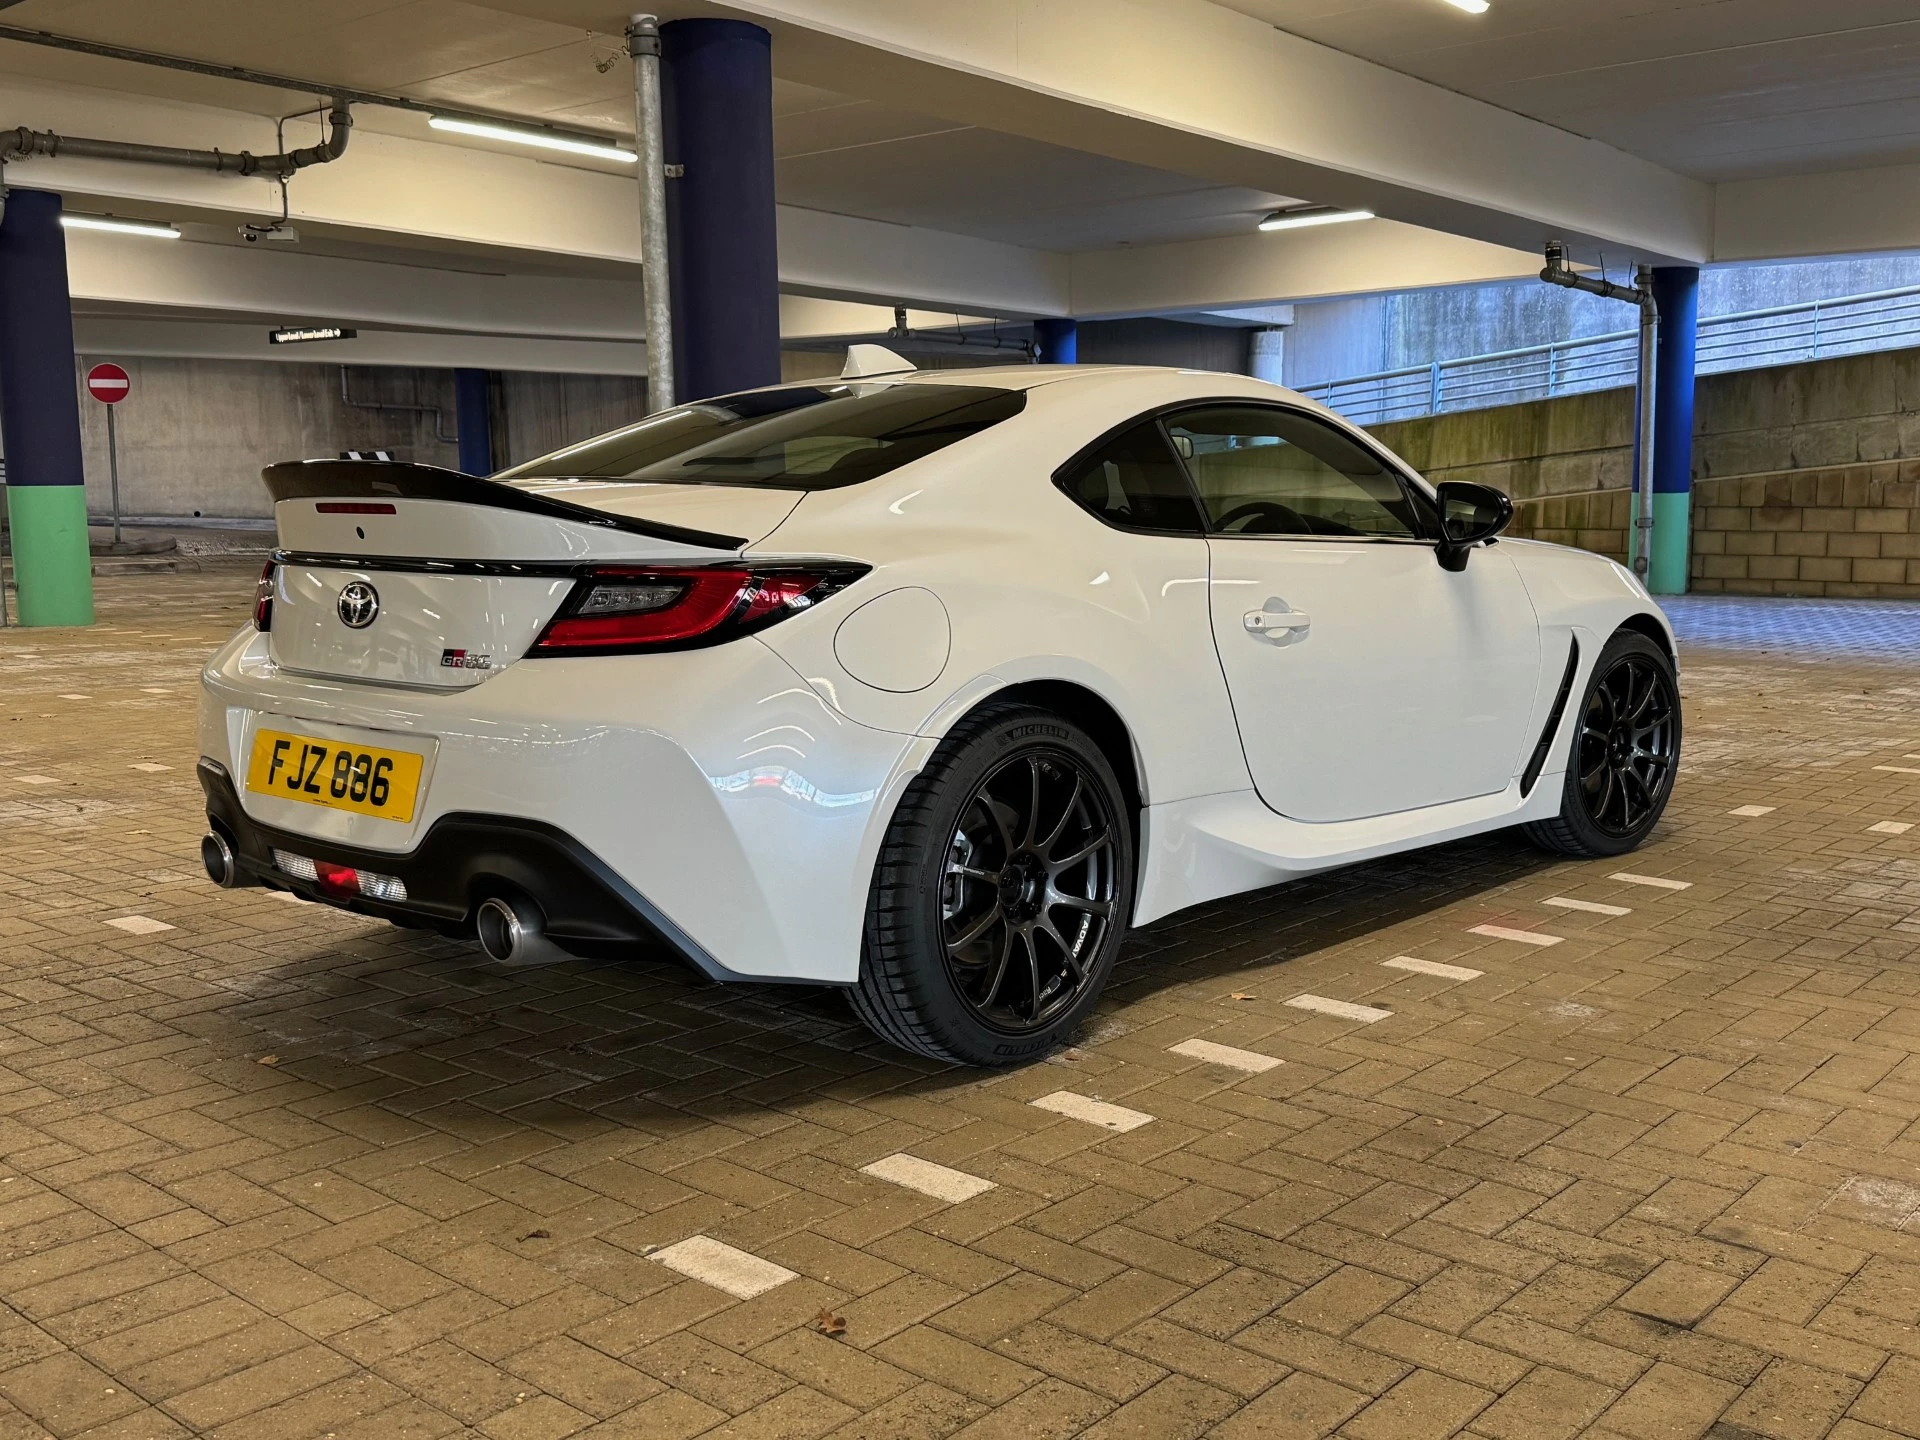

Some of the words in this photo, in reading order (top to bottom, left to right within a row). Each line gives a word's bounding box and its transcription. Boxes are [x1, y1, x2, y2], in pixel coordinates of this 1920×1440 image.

[1012, 724, 1068, 739] MICHELIN
[268, 739, 327, 794] FJZ
[330, 750, 393, 806] 886
